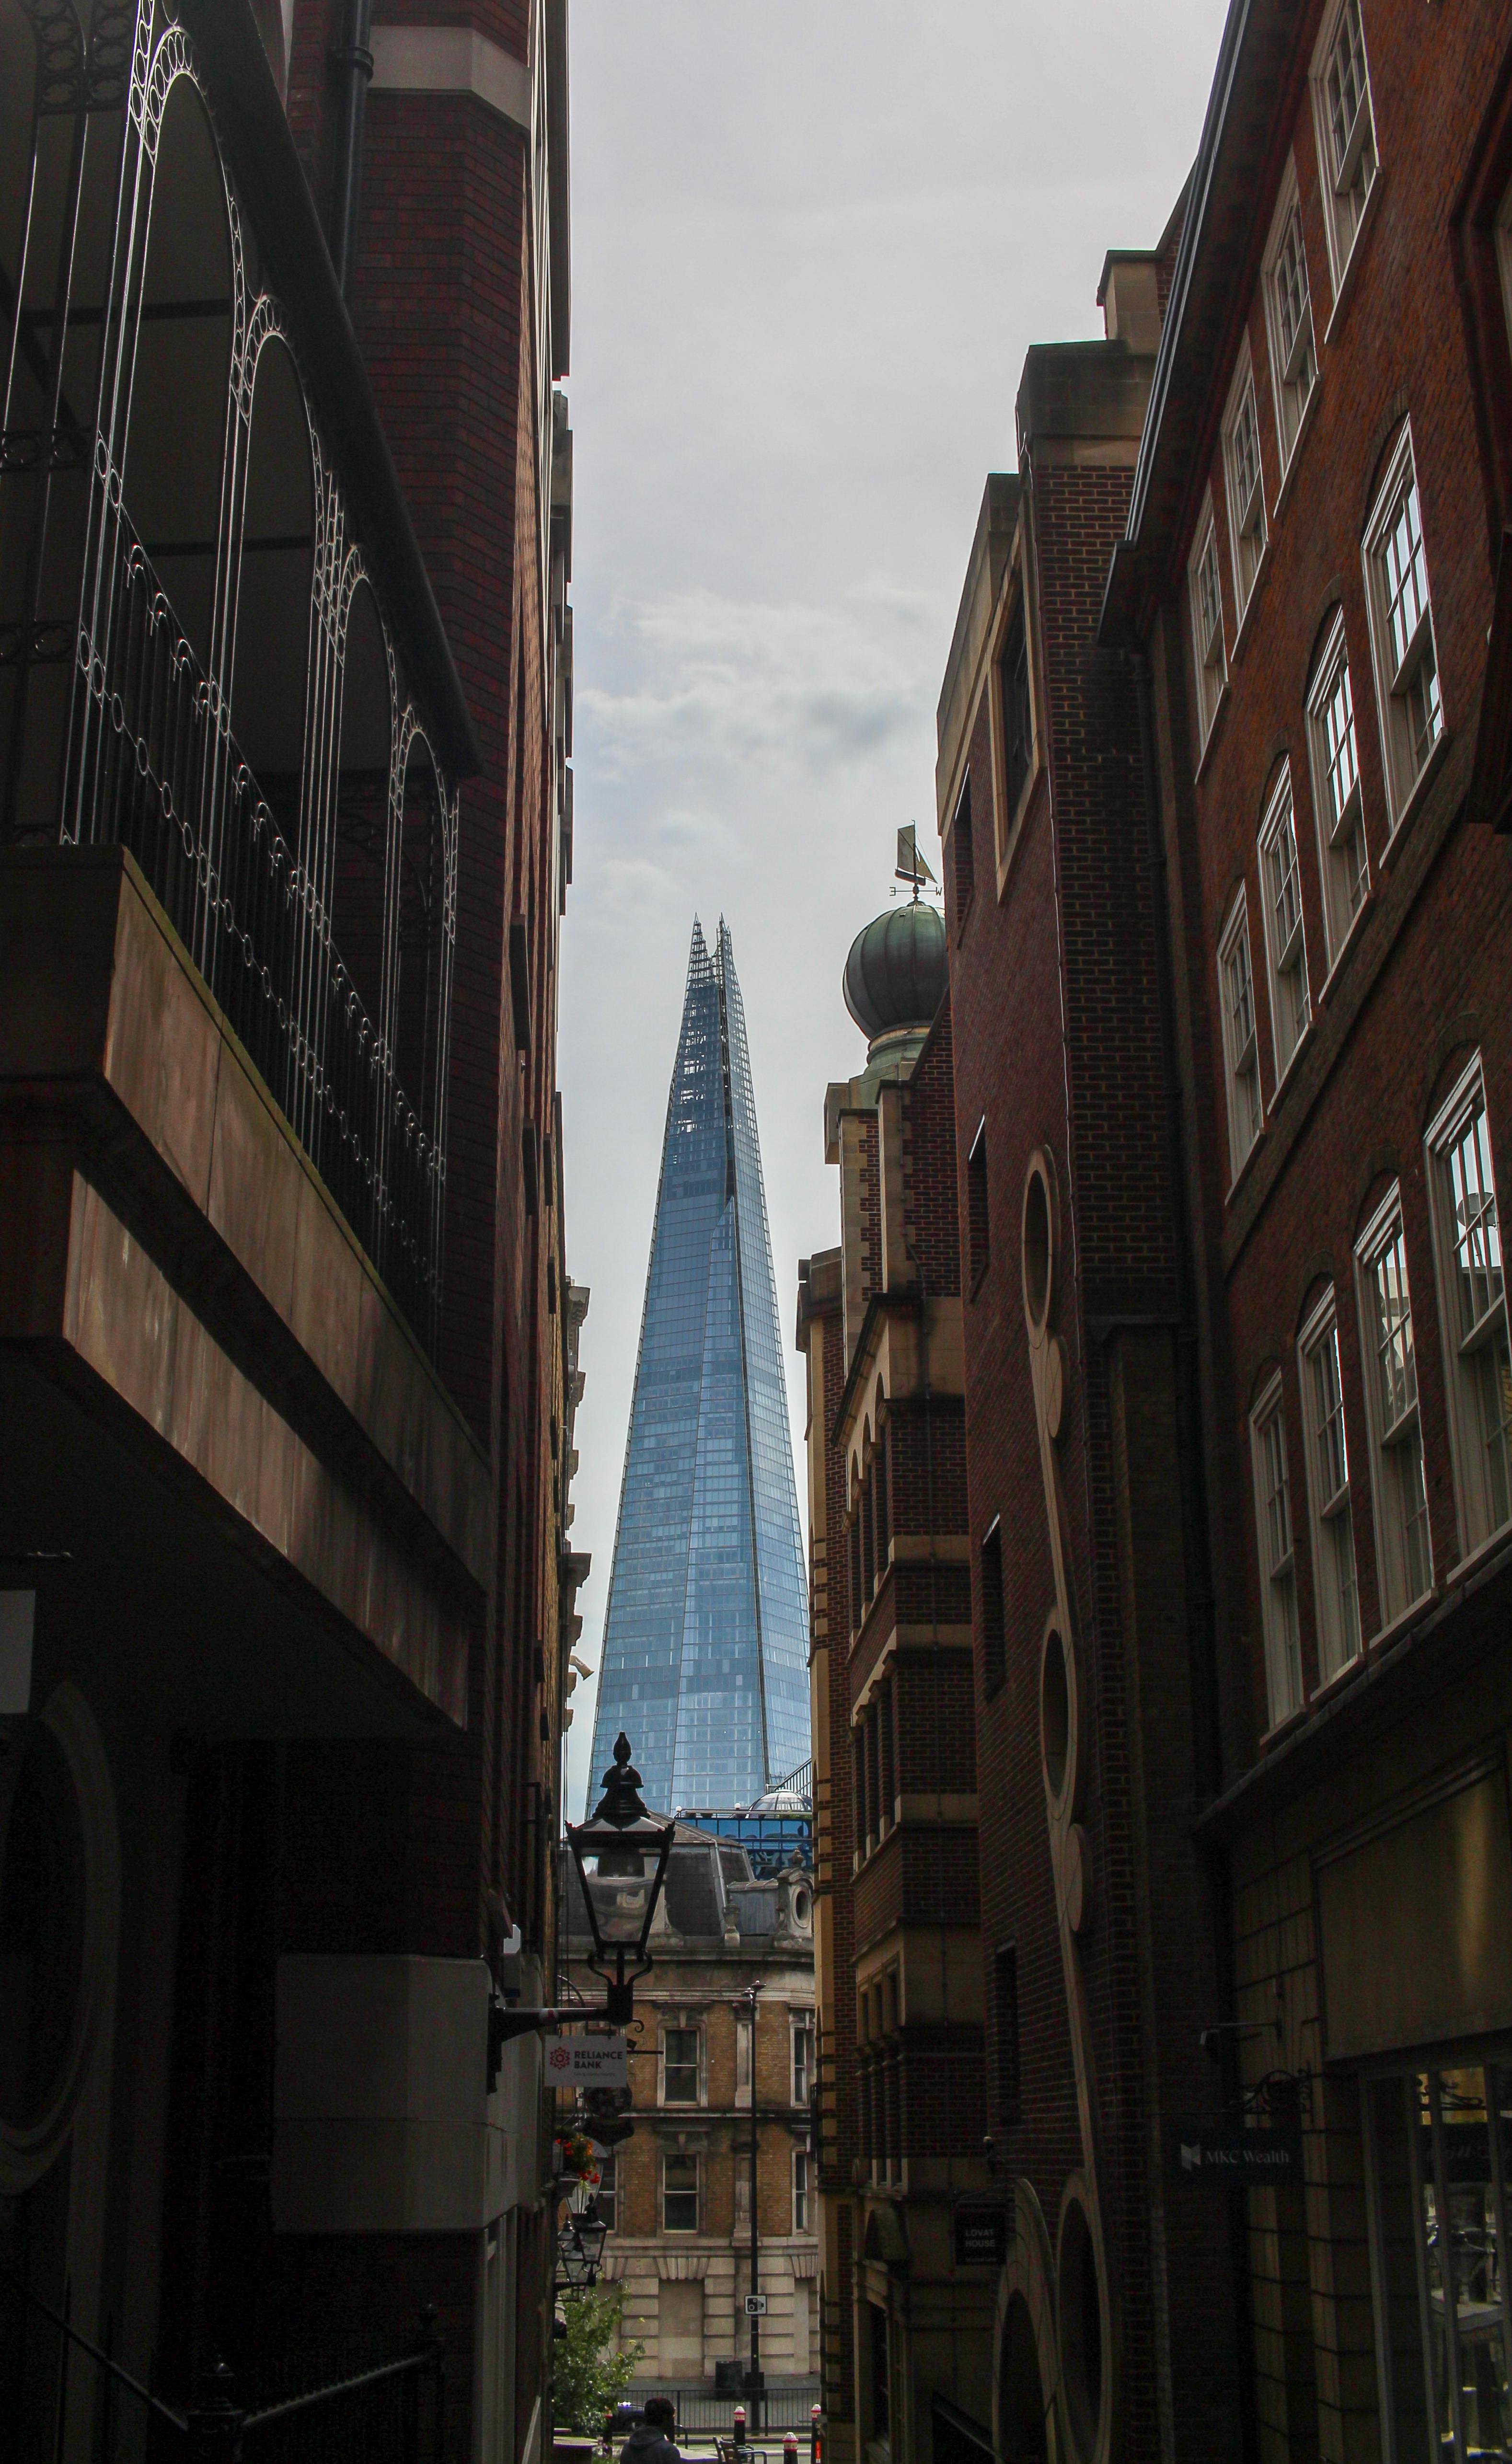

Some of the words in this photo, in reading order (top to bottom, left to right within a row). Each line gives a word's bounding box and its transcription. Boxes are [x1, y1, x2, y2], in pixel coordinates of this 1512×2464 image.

[574, 2051, 623, 2060] RELIANCE
[1206, 2150, 1238, 2163] MKC
[1242, 2150, 1289, 2163] Wealth
[965, 2229, 994, 2237] LOVAT
[965, 2239, 995, 2247] HOUSE
